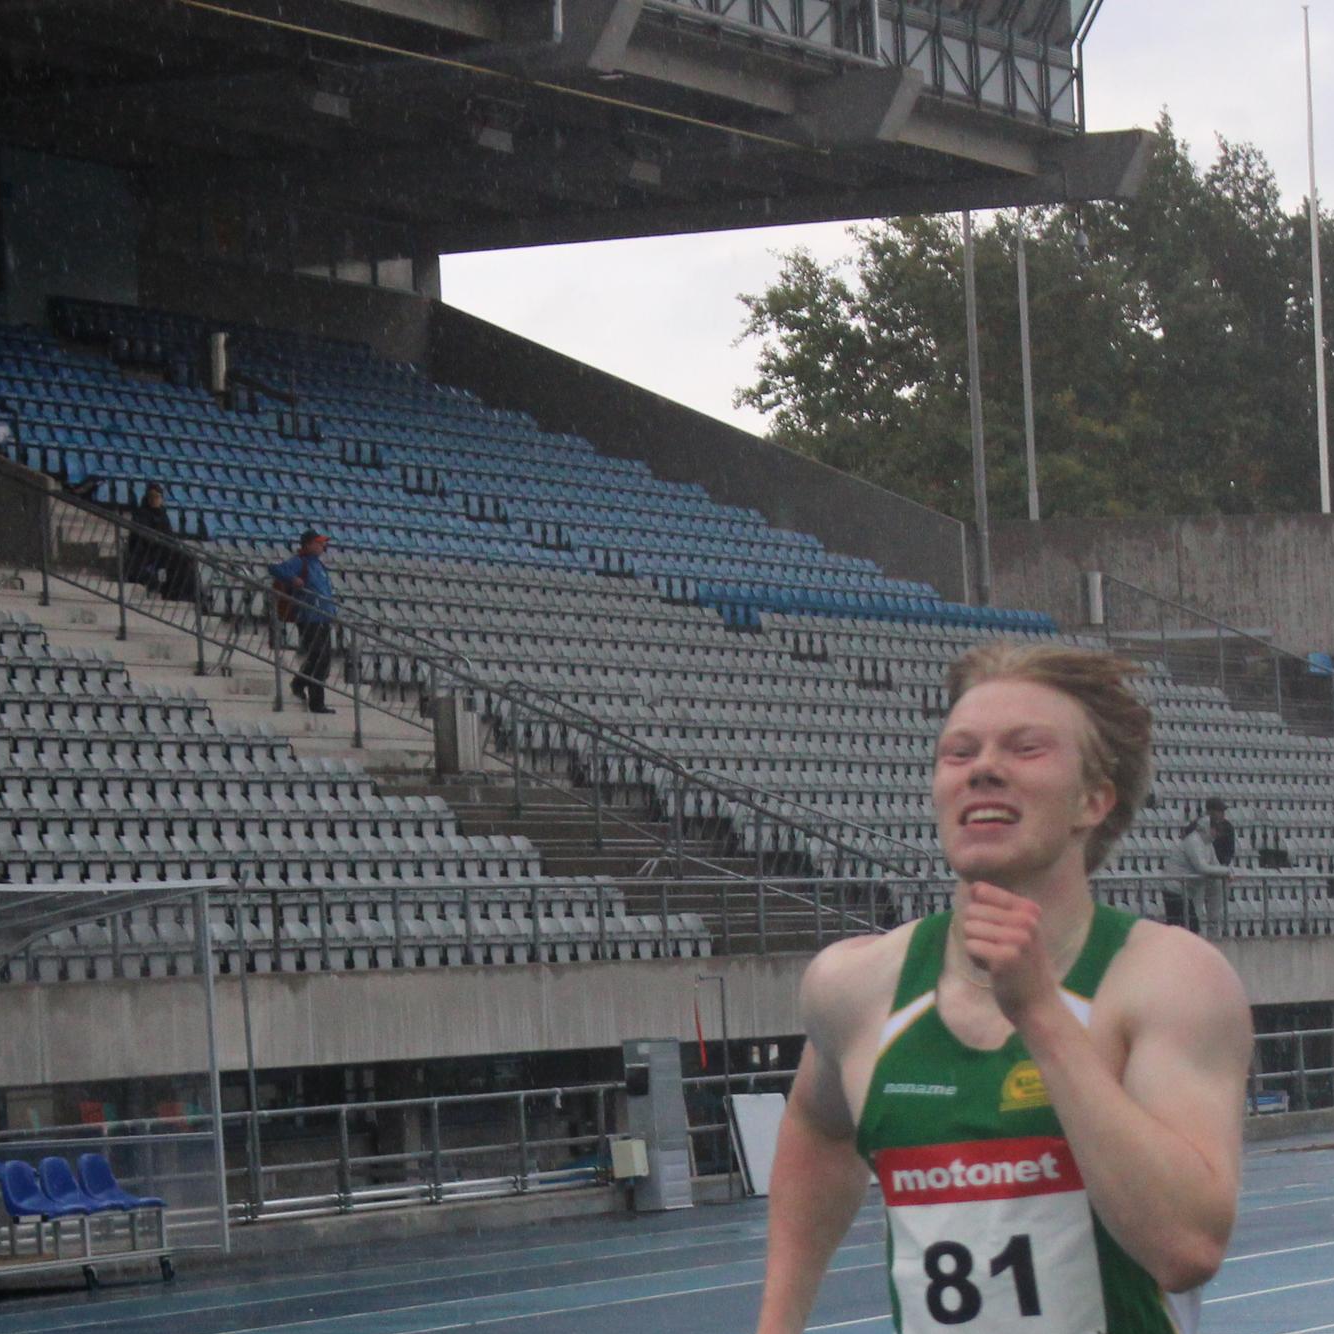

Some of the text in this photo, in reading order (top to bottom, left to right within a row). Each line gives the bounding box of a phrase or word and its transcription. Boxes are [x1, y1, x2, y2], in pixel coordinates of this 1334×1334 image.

[883, 1082, 958, 1096] noname
[892, 1153, 1059, 1192] motonet
[923, 1233, 1042, 1326] 81
